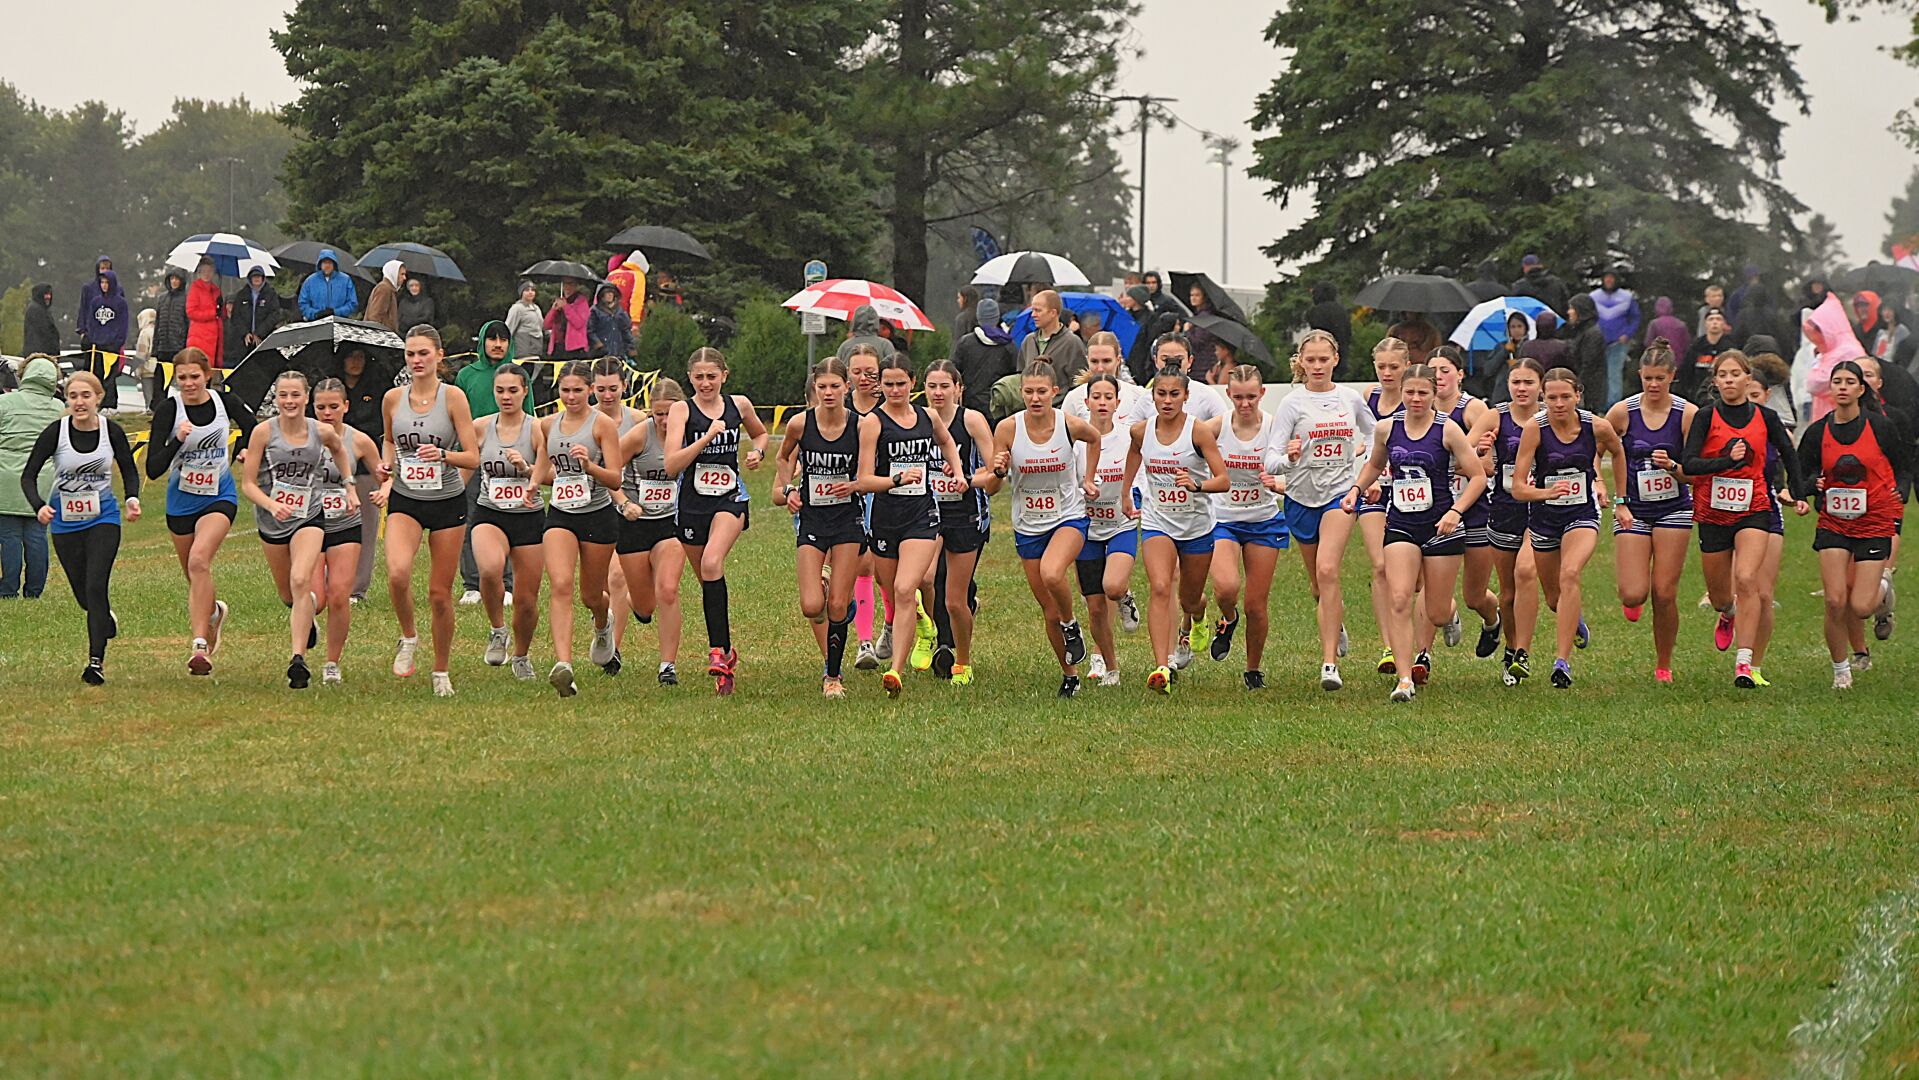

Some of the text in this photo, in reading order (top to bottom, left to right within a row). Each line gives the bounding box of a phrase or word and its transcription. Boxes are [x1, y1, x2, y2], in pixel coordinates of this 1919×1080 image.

[1308, 429, 1353, 440] WARRIORS
[888, 438, 932, 457] UNITY
[1313, 443, 1342, 457] 354
[806, 450, 853, 468] UNITY
[406, 466, 435, 480] 254
[1019, 463, 1066, 474] WARRIORS
[185, 472, 214, 486] 494
[700, 471, 731, 486] 429
[1644, 476, 1673, 492] 158
[494, 485, 523, 500] 260
[556, 484, 584, 500] 263
[644, 488, 671, 501] 258
[815, 483, 833, 496] 42
[1158, 489, 1187, 504] 349
[1231, 489, 1260, 502] 373
[1399, 487, 1425, 502] 164
[1717, 486, 1746, 501] 309
[66, 500, 93, 513] 491
[275, 491, 304, 508] 264
[323, 497, 342, 510] 53
[1025, 496, 1055, 510] 348
[1832, 496, 1860, 511] 312
[1086, 506, 1115, 520] 338
